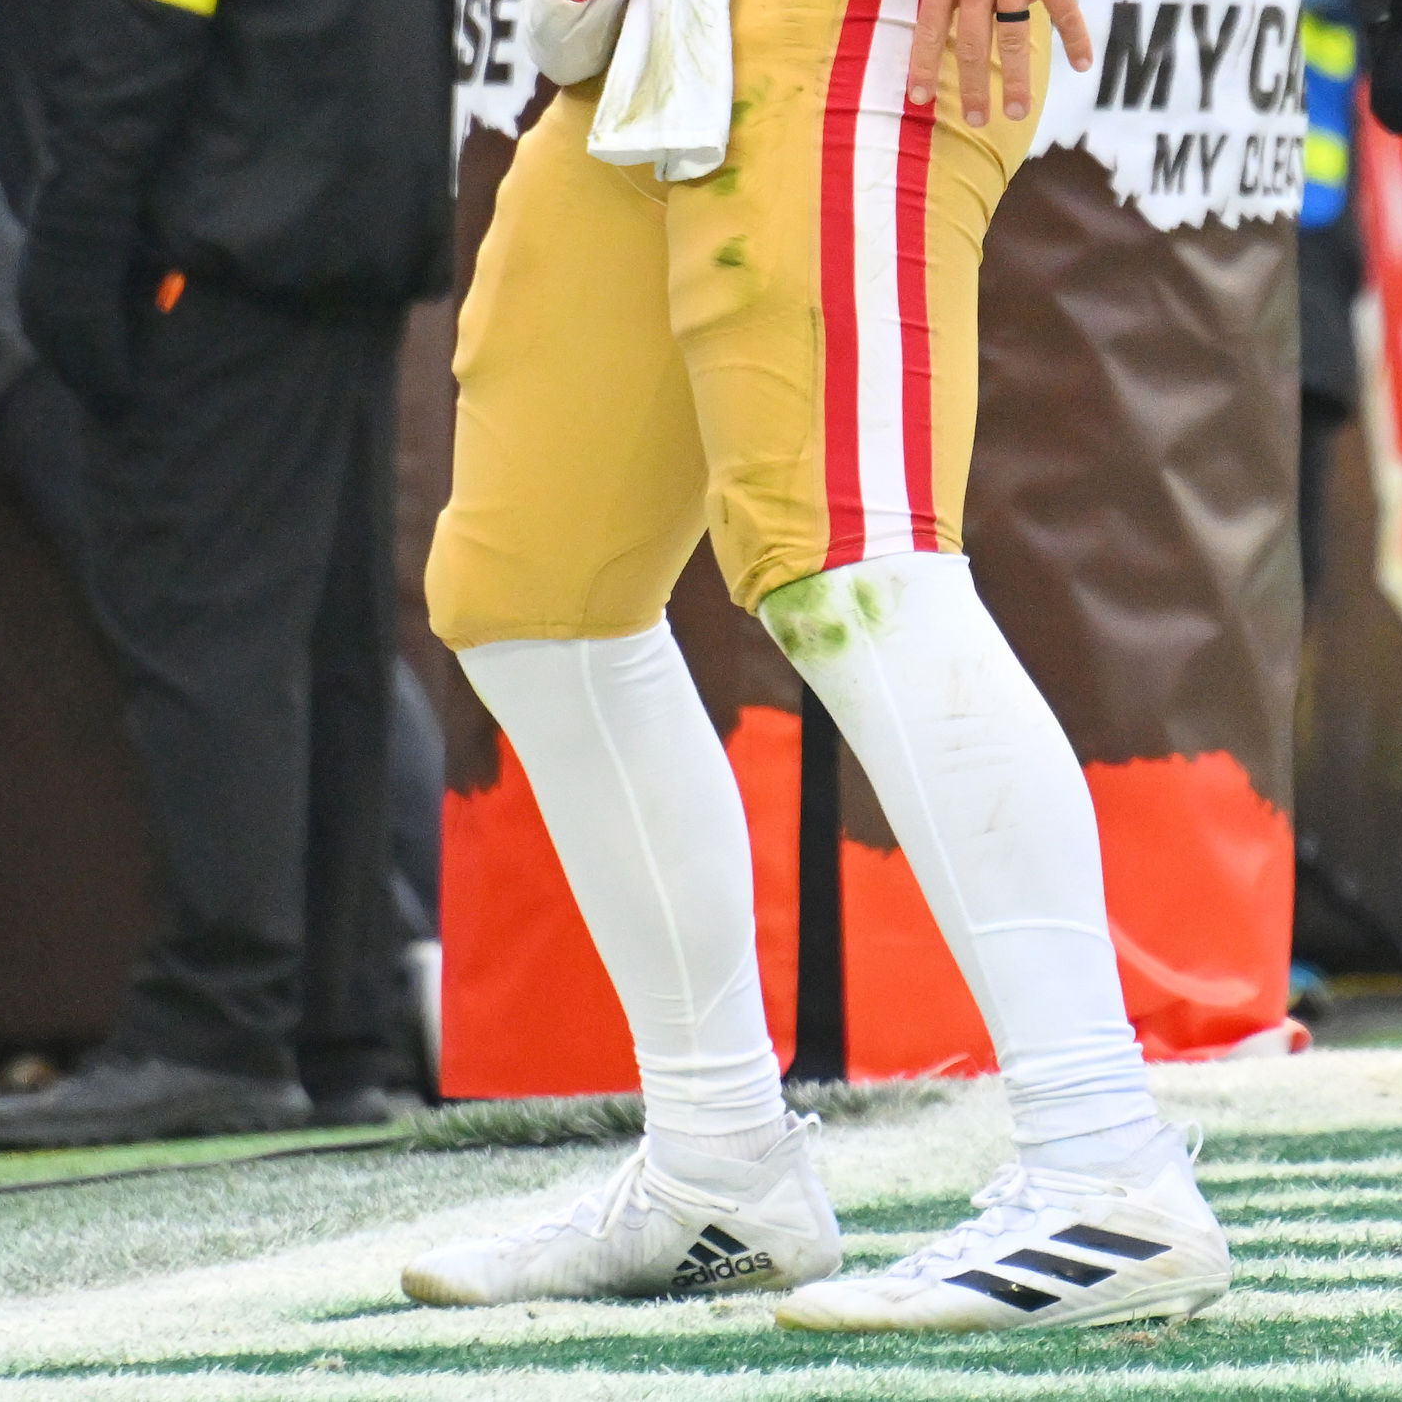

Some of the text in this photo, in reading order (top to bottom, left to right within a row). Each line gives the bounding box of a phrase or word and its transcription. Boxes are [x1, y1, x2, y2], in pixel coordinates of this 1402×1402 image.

[1096, 2, 1240, 111] MY
[1151, 132, 1228, 196] MY
[671, 1251, 774, 1288] adidas
